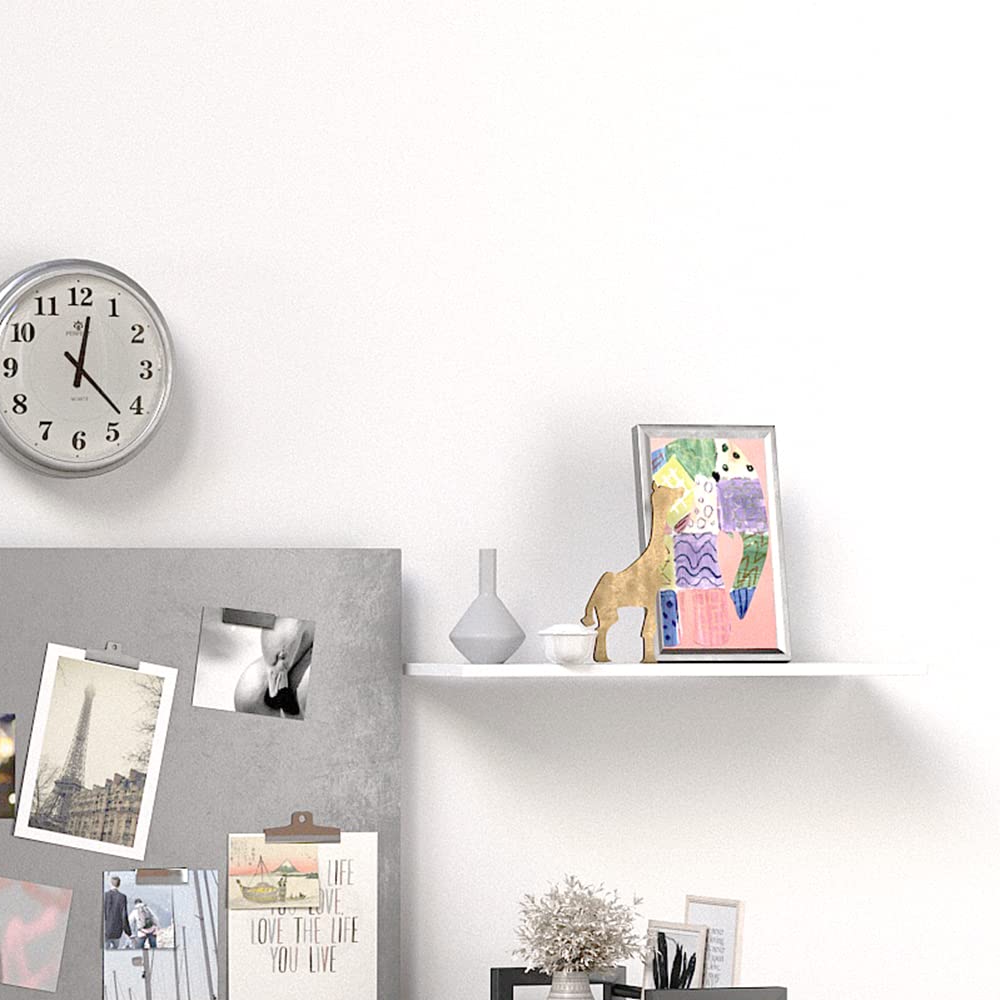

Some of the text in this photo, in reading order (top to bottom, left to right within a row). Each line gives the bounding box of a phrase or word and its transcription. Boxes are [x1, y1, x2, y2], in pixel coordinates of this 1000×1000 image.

[68, 287, 92, 306] 12
[35, 297, 59, 316] 11
[109, 298, 119, 317] 1
[11, 323, 35, 342] 10
[131, 324, 144, 343] 2
[3, 358, 18, 378] 9
[140, 360, 152, 379] 3
[12, 394, 27, 414] 8
[130, 396, 143, 415] 4
[39, 421, 52, 440] 7
[106, 423, 119, 441] 5
[72, 431, 86, 450] 6
[328, 859, 354, 886] LIFE
[251, 916, 359, 944] LOVE THE LIFE
[270, 946, 336, 973] YOU LIVE
